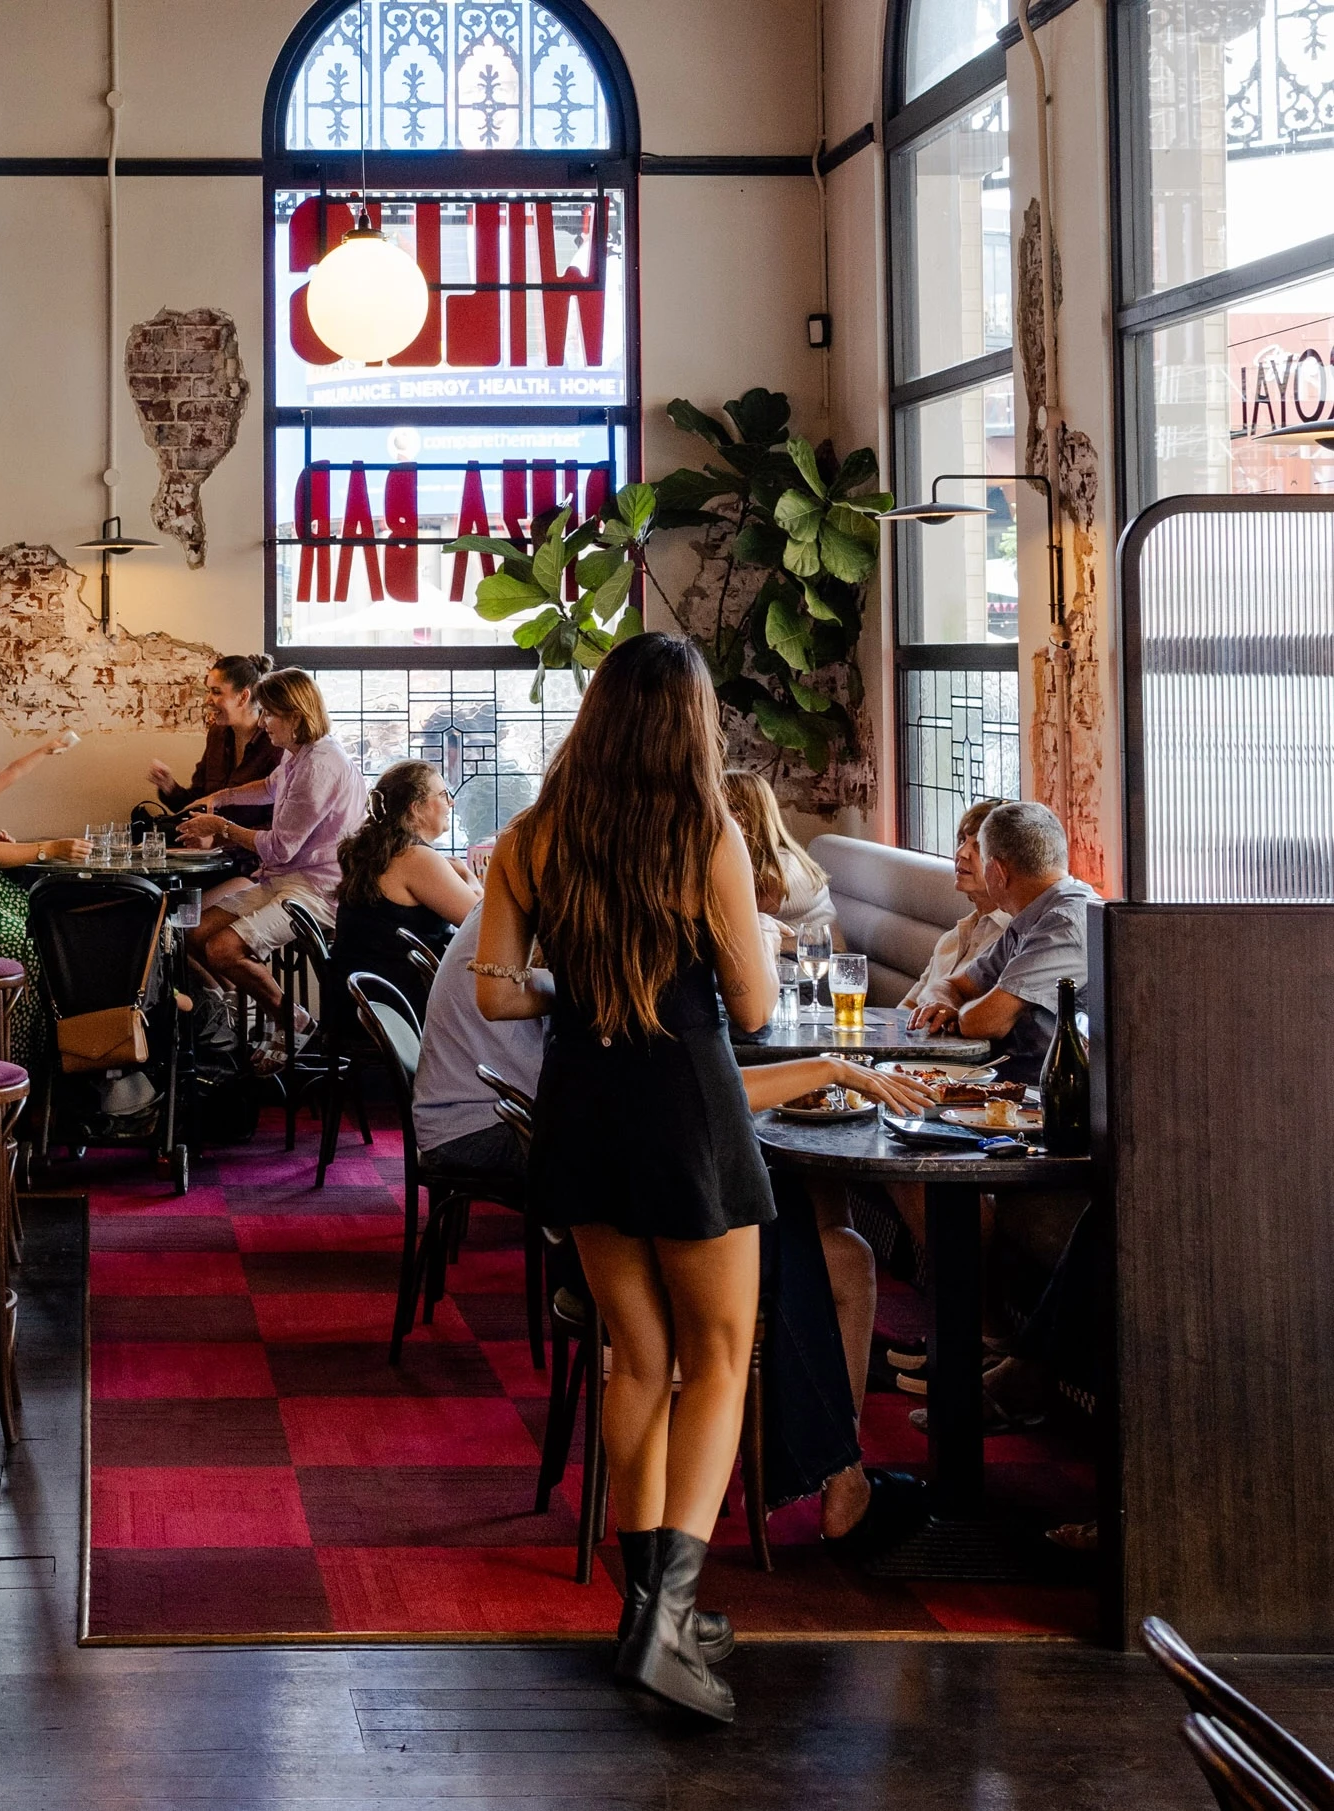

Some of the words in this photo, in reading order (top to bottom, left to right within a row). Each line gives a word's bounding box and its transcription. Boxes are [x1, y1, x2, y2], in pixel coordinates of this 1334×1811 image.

[399, 379, 474, 398] ENERGY.
[478, 377, 555, 396] HEALTH.
[559, 378, 616, 396] HOME
